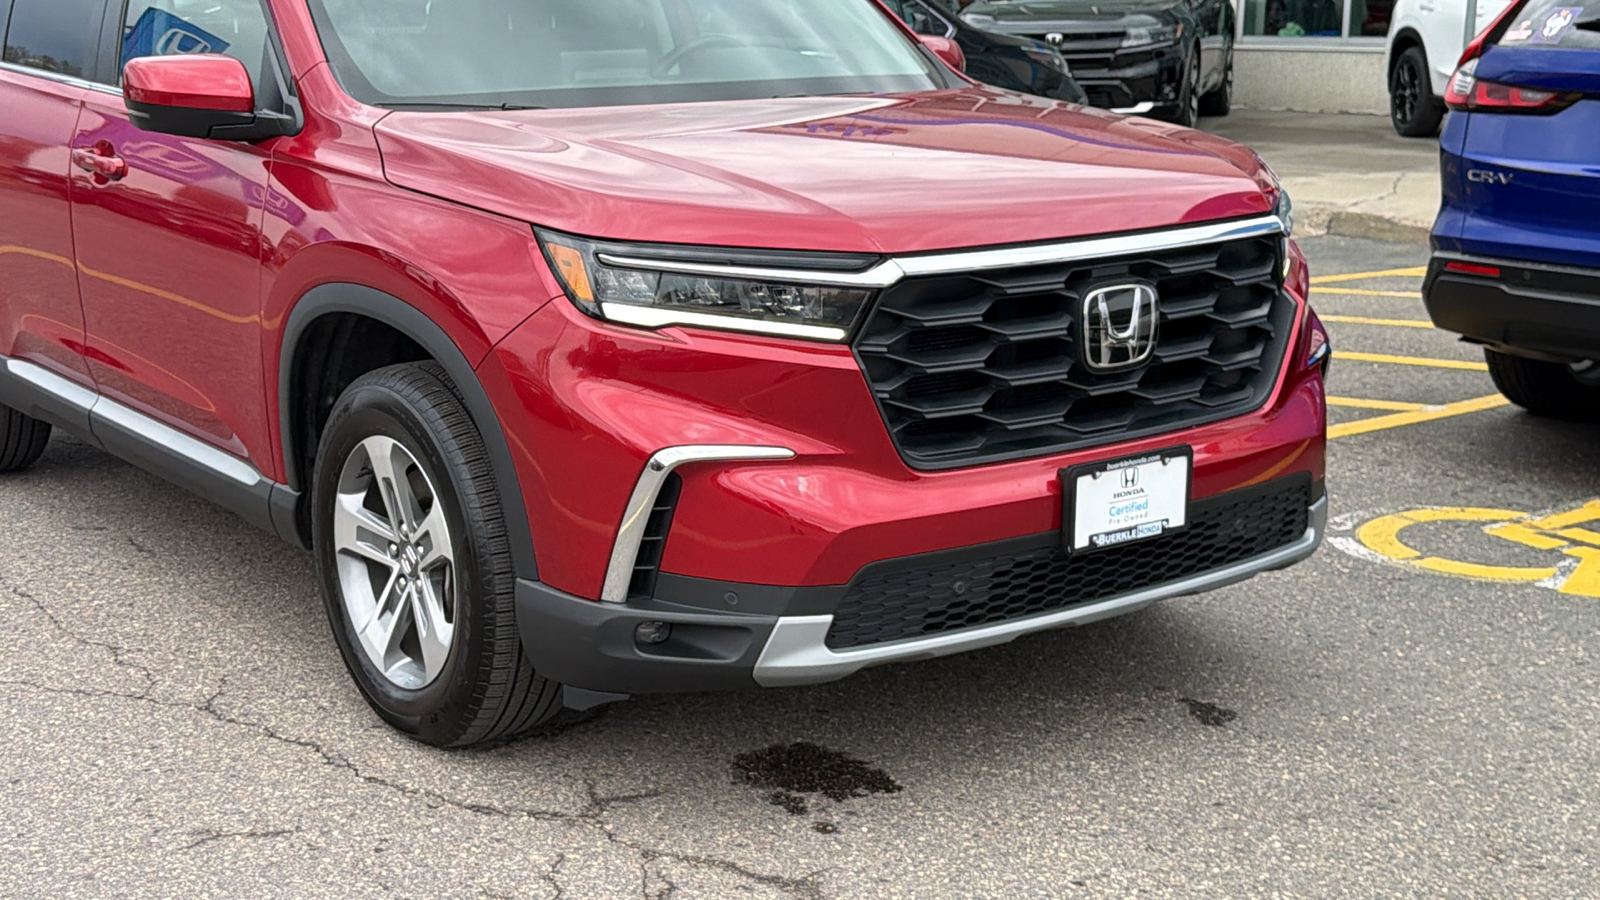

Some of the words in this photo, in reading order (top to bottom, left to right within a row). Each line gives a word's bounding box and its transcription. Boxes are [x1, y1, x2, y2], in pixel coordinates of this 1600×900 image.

[1467, 169, 1514, 185] CR-V
[1106, 455, 1161, 470] buerklehonda.com
[1113, 487, 1145, 499] HONDA
[1109, 499, 1148, 517] Certified
[1109, 512, 1148, 525] Pre-Owned
